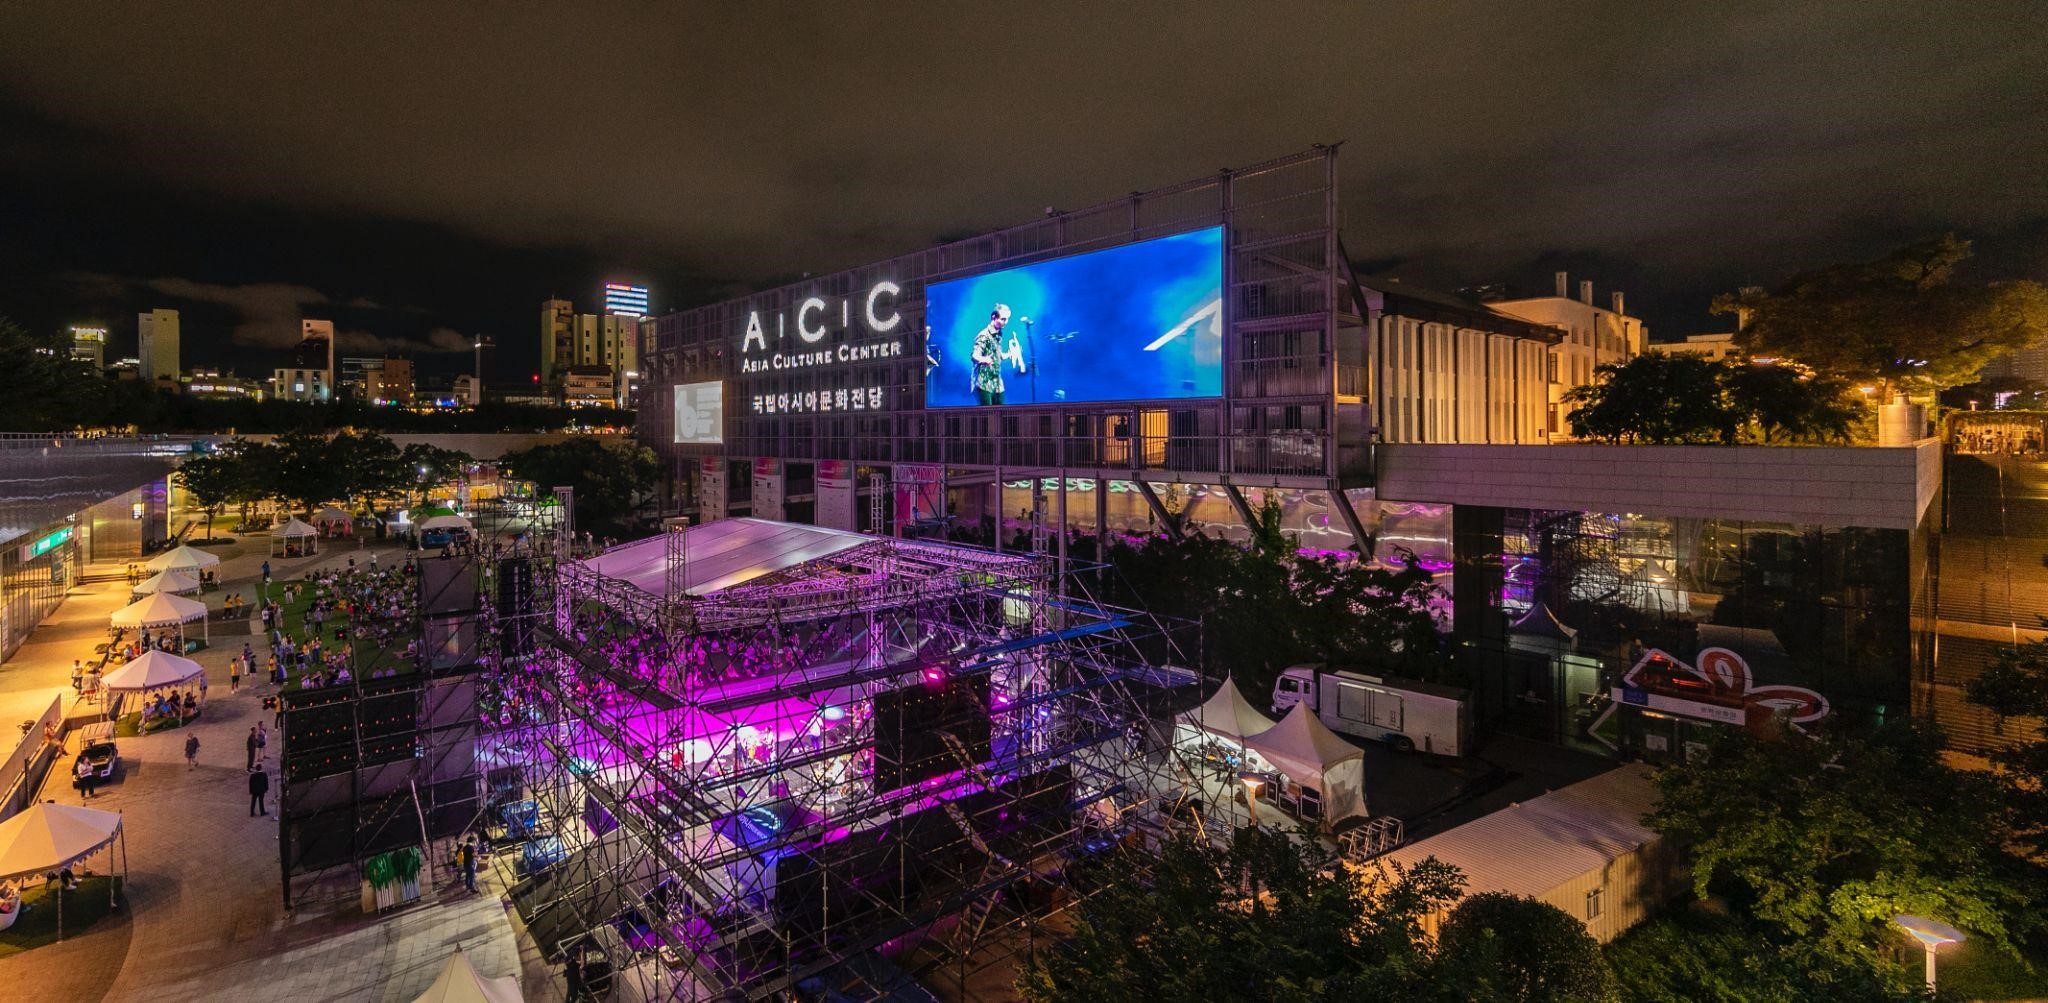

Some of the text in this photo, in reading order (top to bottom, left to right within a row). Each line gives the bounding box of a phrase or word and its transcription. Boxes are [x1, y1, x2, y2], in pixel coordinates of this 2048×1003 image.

[742, 342, 902, 373] ASIA CULTURE CENTER
[753, 386, 883, 414] 국립아시아문화전당
